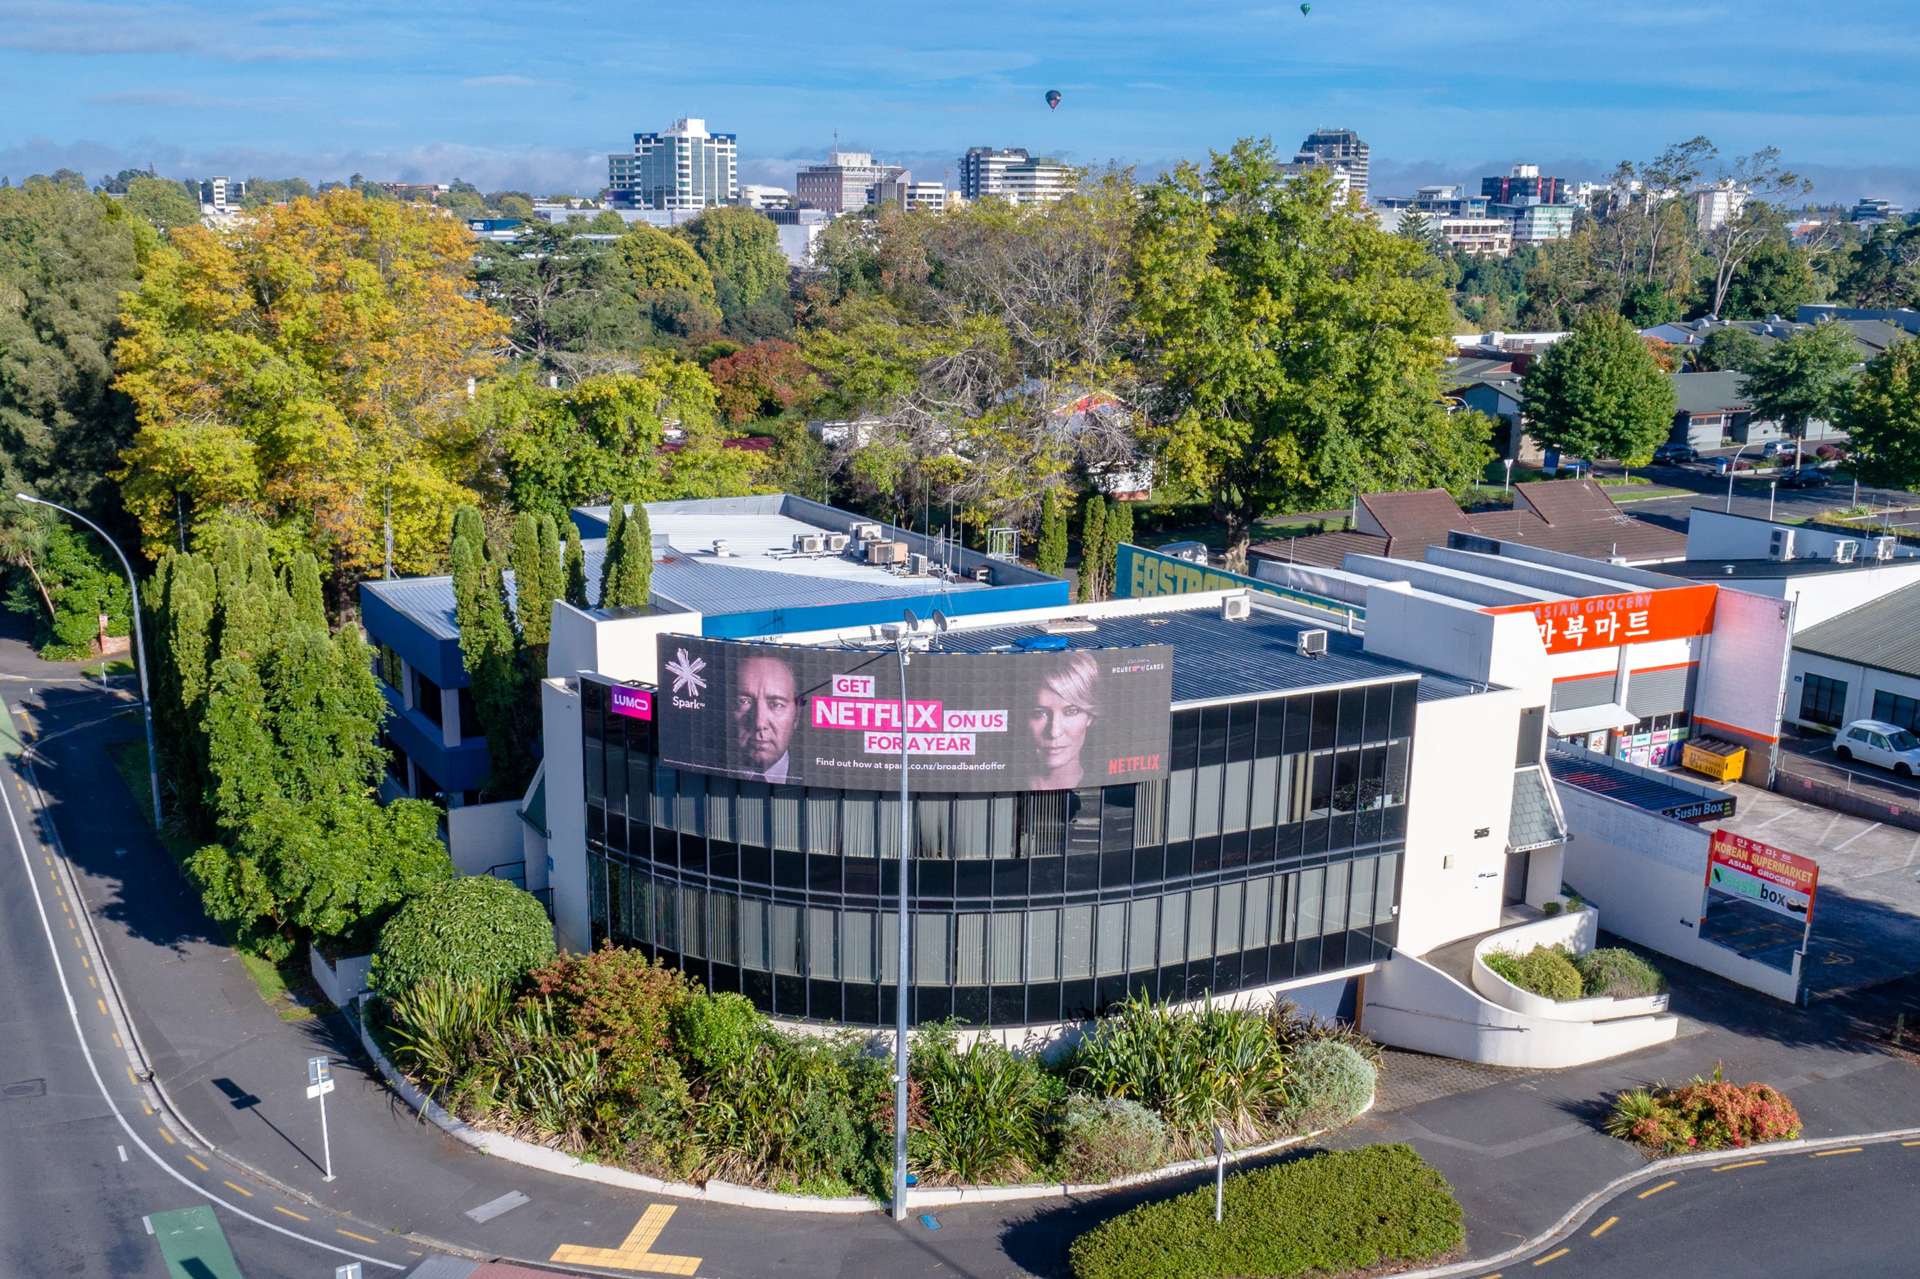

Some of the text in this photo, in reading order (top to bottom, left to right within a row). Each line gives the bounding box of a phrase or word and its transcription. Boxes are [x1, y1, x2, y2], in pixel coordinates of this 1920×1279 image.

[1535, 594, 1652, 619] ASIAN GROCERY
[837, 679, 870, 693] GET
[614, 694, 648, 711] LUMO
[816, 700, 1003, 728] NETFLIX ON US
[868, 735, 971, 751] FOR A YEAR
[816, 757, 835, 767] Find
[837, 760, 852, 768] out
[854, 759, 872, 769] how
[874, 761, 882, 769] at
[1108, 754, 1160, 775] NETFLIX
[1675, 807, 1702, 820] Sushi
[1704, 802, 1724, 814] Box
[1714, 841, 1813, 883] KOREAN SUPERMARKET
[1728, 859, 1797, 886] ASIAN GROCERY
[1760, 884, 1785, 906] box
